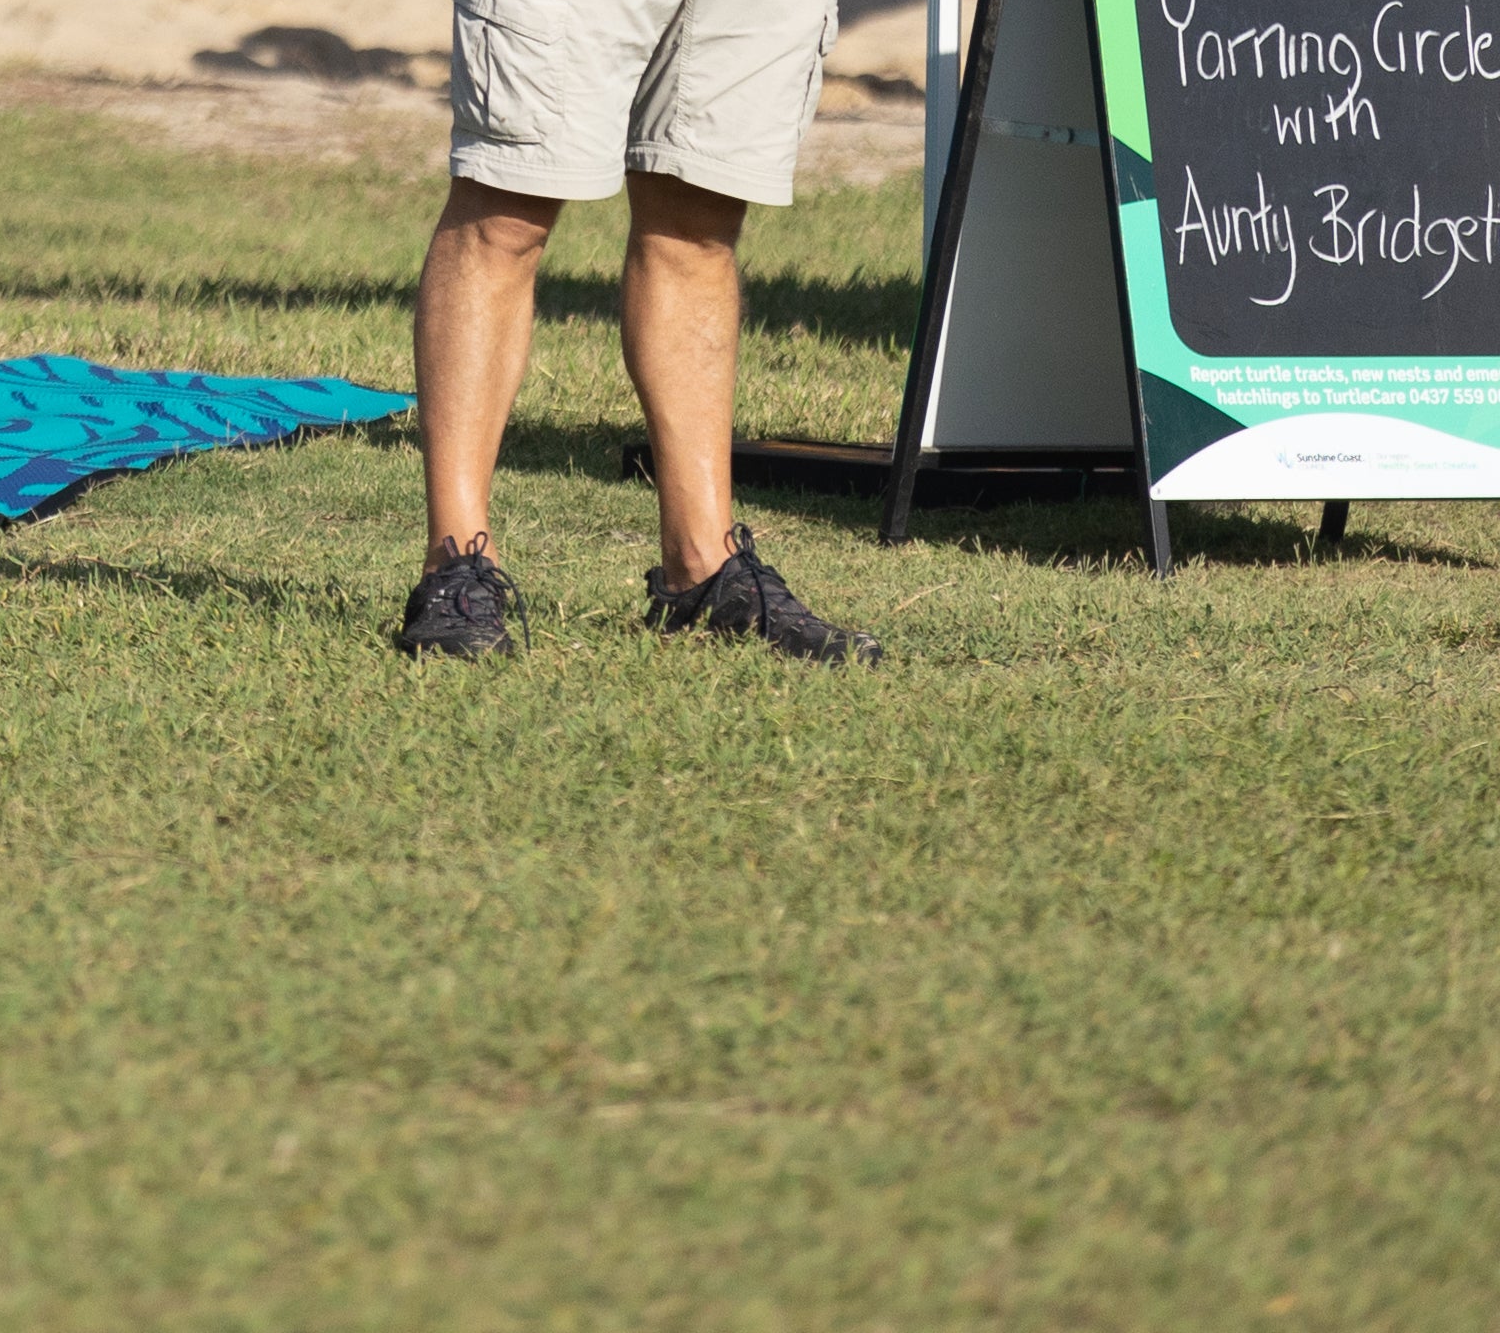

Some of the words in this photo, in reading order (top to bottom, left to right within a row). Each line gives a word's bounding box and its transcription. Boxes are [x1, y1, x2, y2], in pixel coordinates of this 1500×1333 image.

[1372, 0, 1500, 83] Circle
[1272, 86, 1381, 145] with
[1174, 163, 1298, 307] Aunty
[1189, 365, 1244, 387] Report
[1245, 364, 1292, 383] turtle
[1294, 364, 1350, 385] tracks,
[1351, 367, 1384, 383] new
[1386, 365, 1432, 383] nests
[1433, 364, 1463, 383] and
[1216, 387, 1300, 410] hatchlings
[1302, 389, 1321, 406] to
[1323, 388, 1406, 406] TurtleCare
[1408, 388, 1449, 405] 0437
[1453, 388, 1485, 405] 559
[1296, 452, 1336, 464] Sunshine
[1337, 452, 1363, 464] Coast
